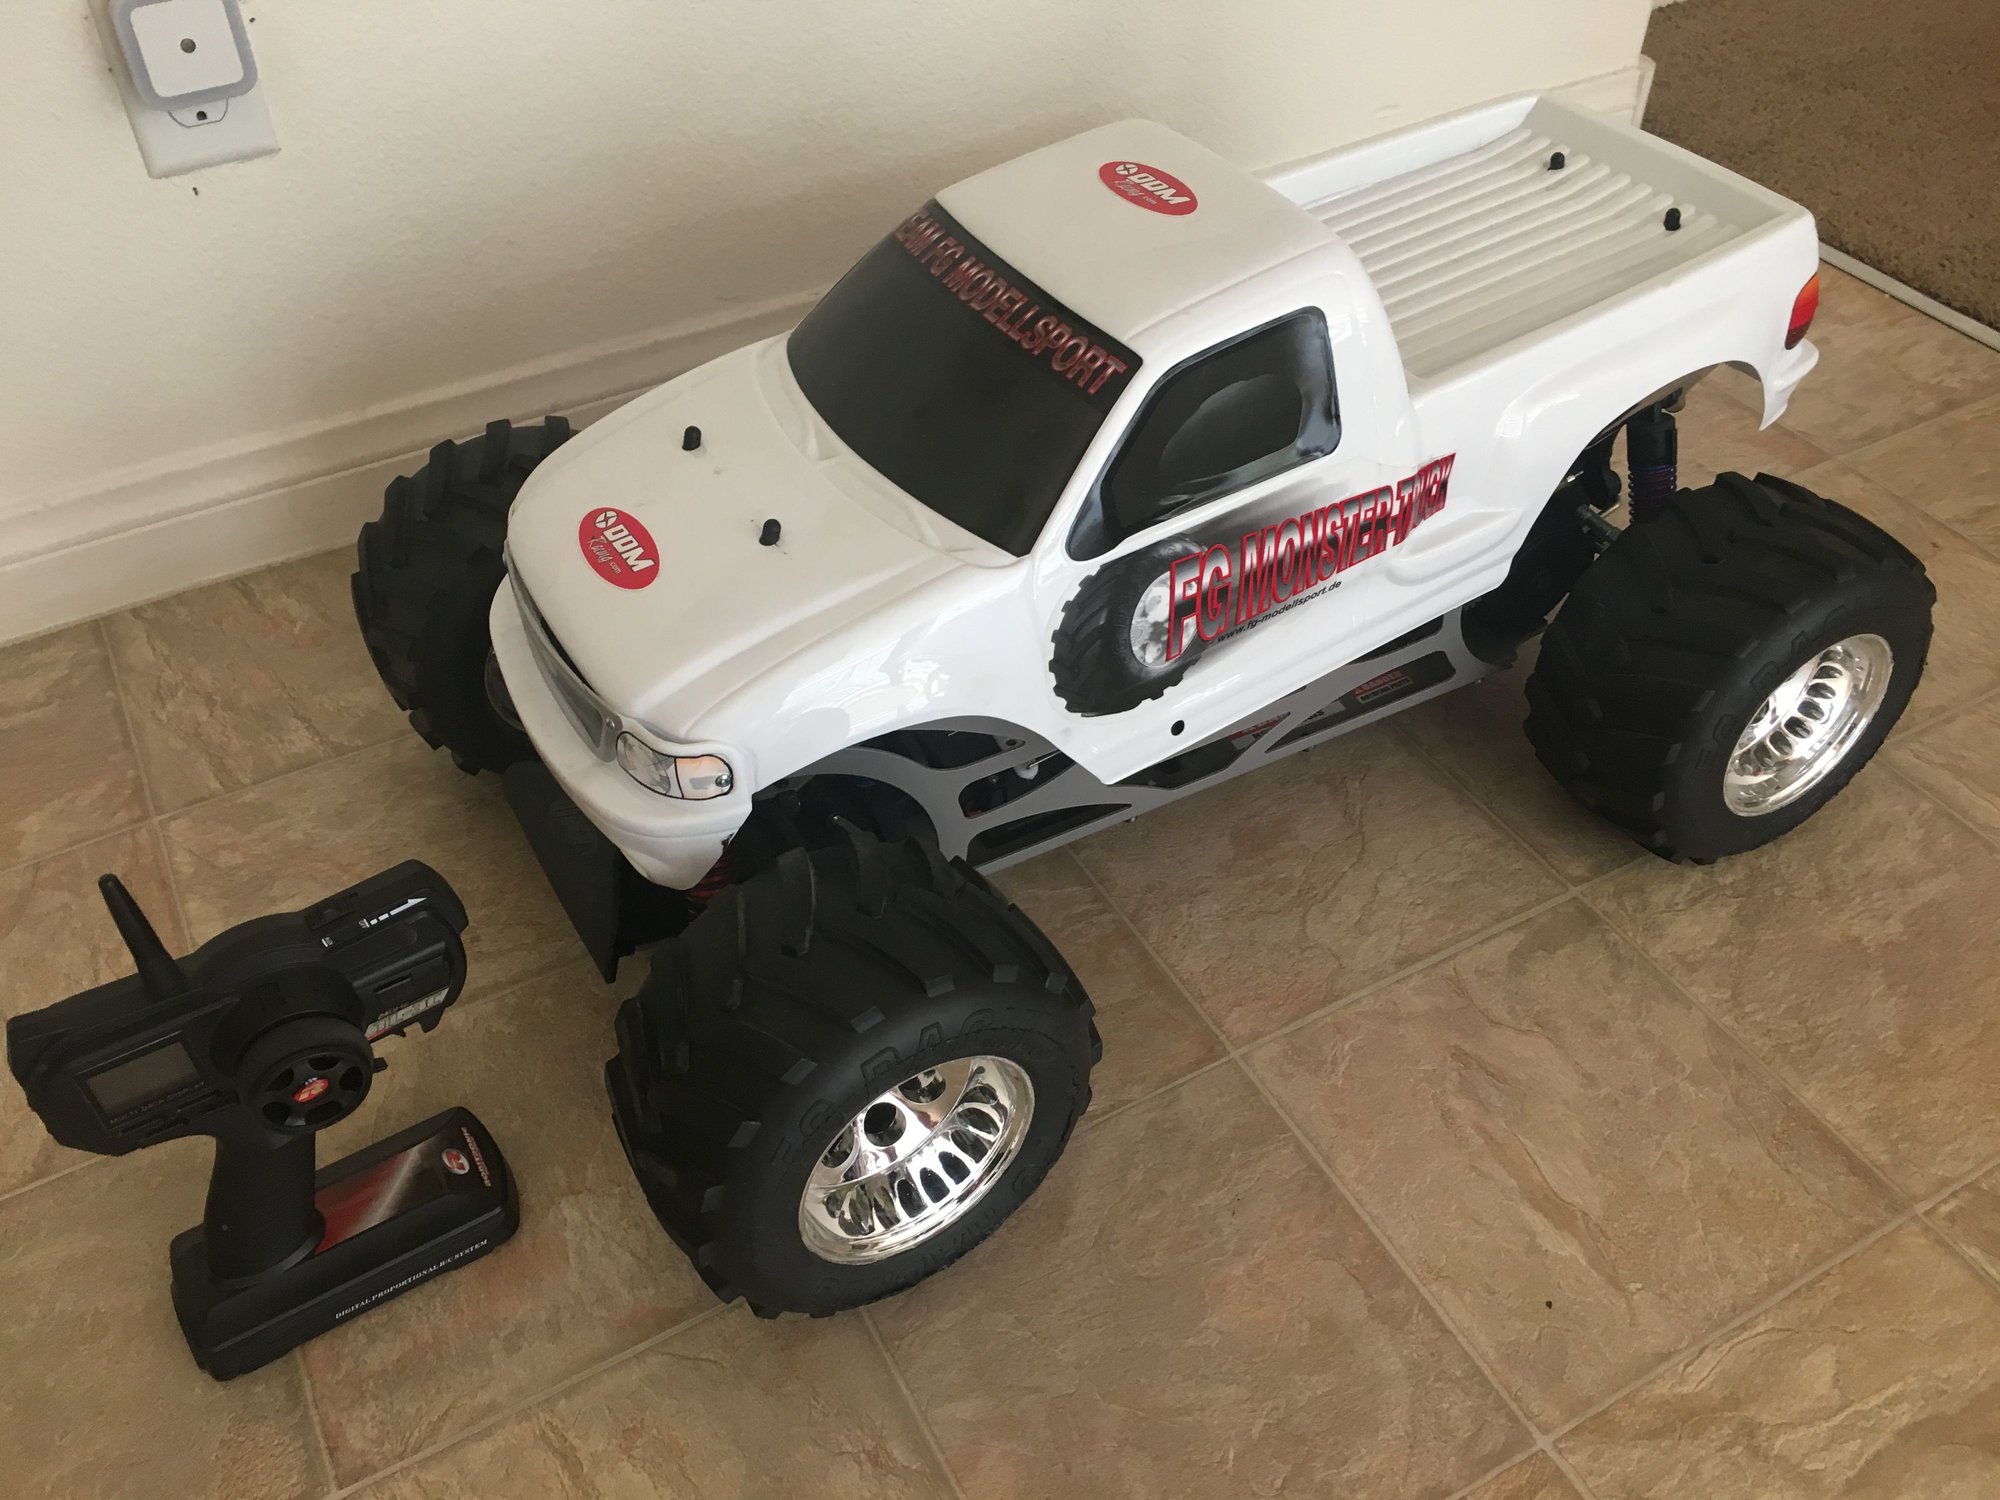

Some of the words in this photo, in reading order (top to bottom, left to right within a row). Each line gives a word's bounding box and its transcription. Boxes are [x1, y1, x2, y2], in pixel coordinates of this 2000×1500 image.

[1127, 172, 1191, 205] DDM
[920, 235, 965, 277] FG
[941, 255, 1128, 396] MODELLSPORT
[602, 523, 656, 573] DDM
[1165, 543, 1234, 662] FG
[1215, 579, 1343, 643] www.fg-modellsport.de
[335, 1298, 371, 1320] DIGITAL
[372, 1263, 439, 1302] PROPORTIONAL
[453, 1238, 488, 1259] SYSTEM
